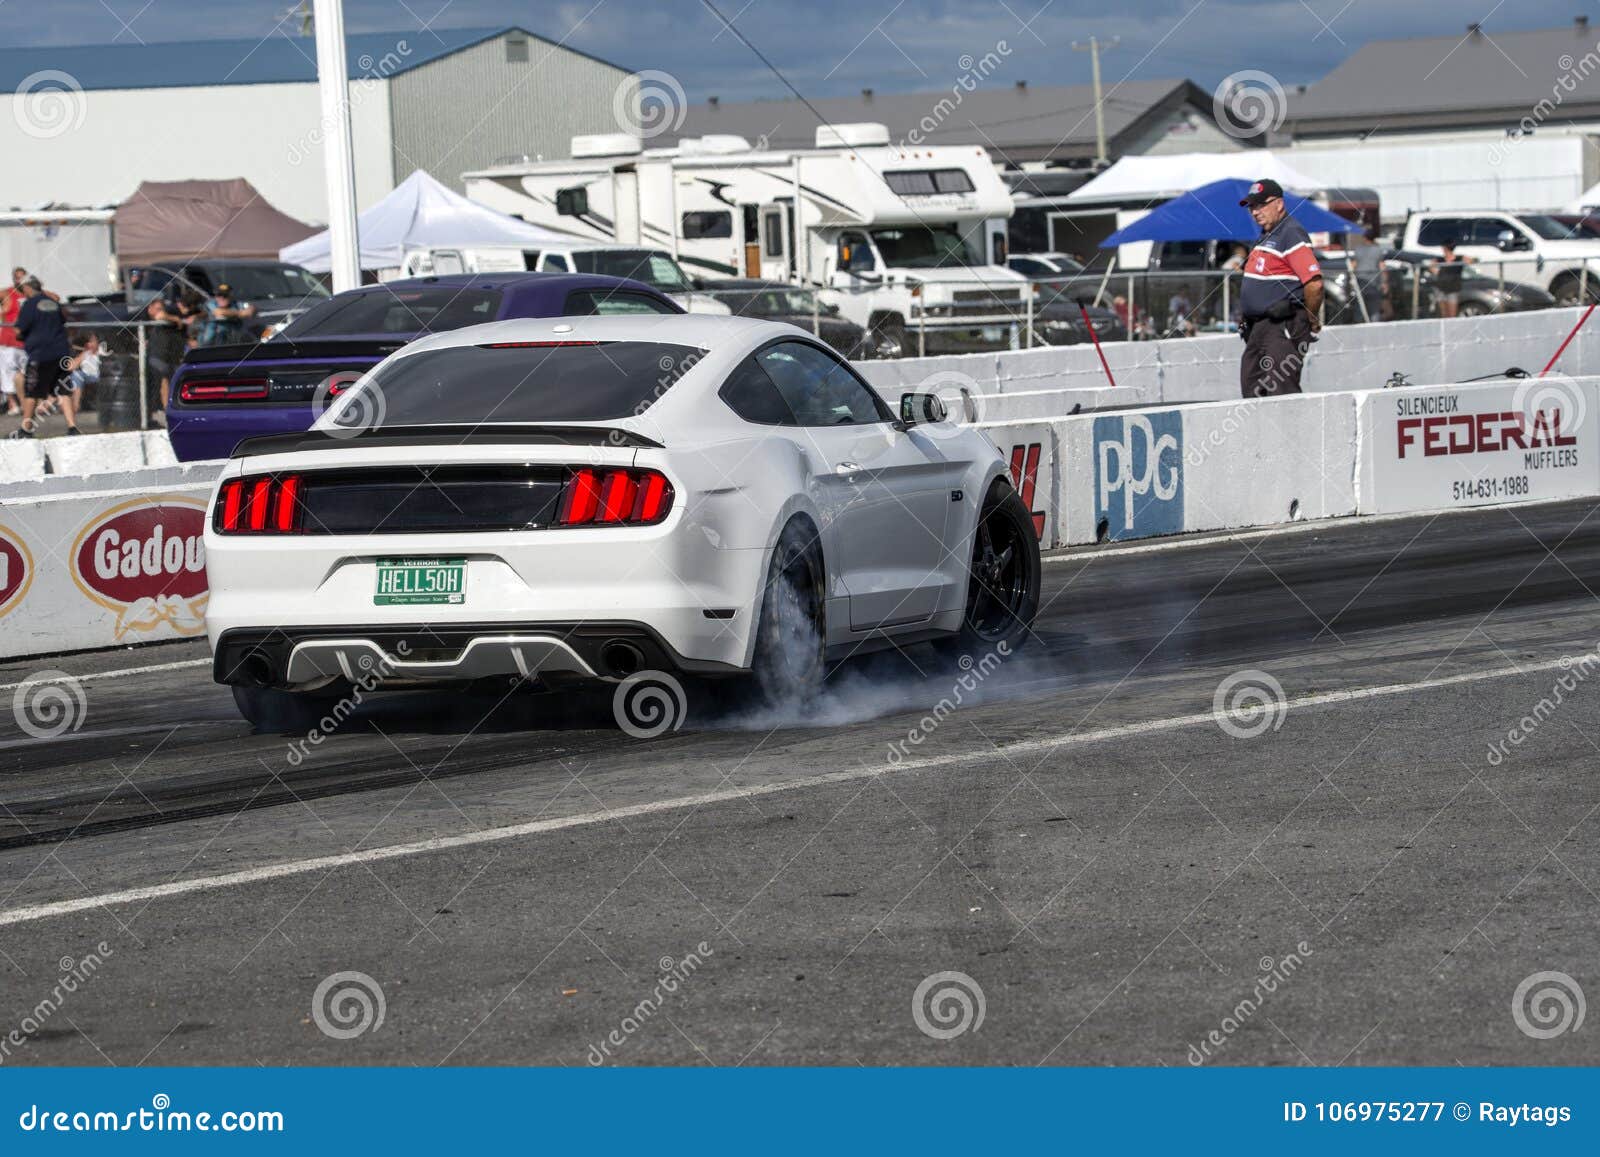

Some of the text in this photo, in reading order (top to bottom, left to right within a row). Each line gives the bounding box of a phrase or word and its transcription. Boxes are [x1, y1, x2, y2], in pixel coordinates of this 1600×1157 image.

[1397, 396, 1458, 416] SILENCIEUX
[1397, 408, 1577, 459] FEDERAL
[1524, 449, 1578, 470] MUFFLERS
[1453, 476, 1529, 500] 514-631-1988
[94, 524, 207, 580] Gadou
